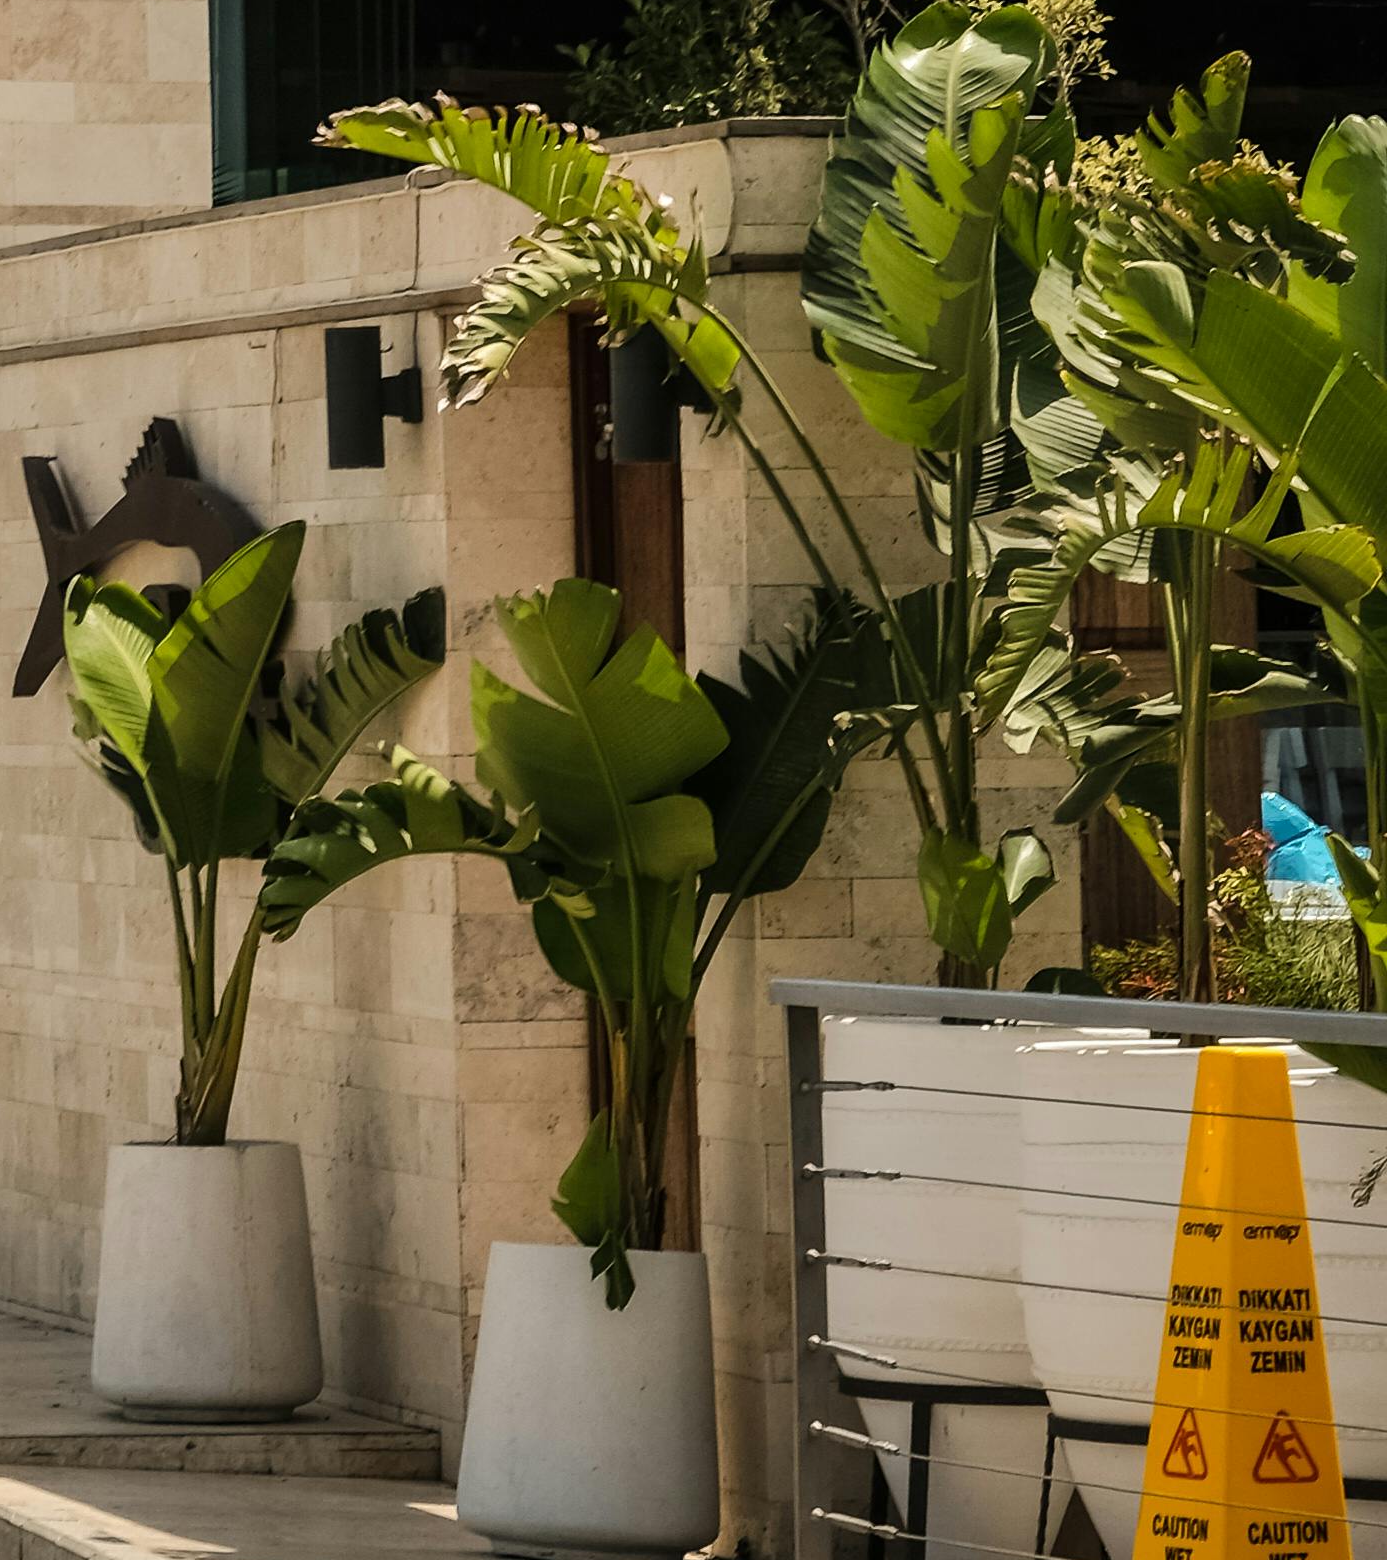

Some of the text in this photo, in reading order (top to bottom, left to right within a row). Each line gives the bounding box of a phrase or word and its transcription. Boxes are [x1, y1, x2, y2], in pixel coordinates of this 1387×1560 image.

[1168, 1315, 1221, 1340] KAYGAN
[1239, 1319, 1314, 1342] KAYGAN
[1152, 1514, 1209, 1541] CAUTION
[1247, 1521, 1329, 1545] CAUTION
